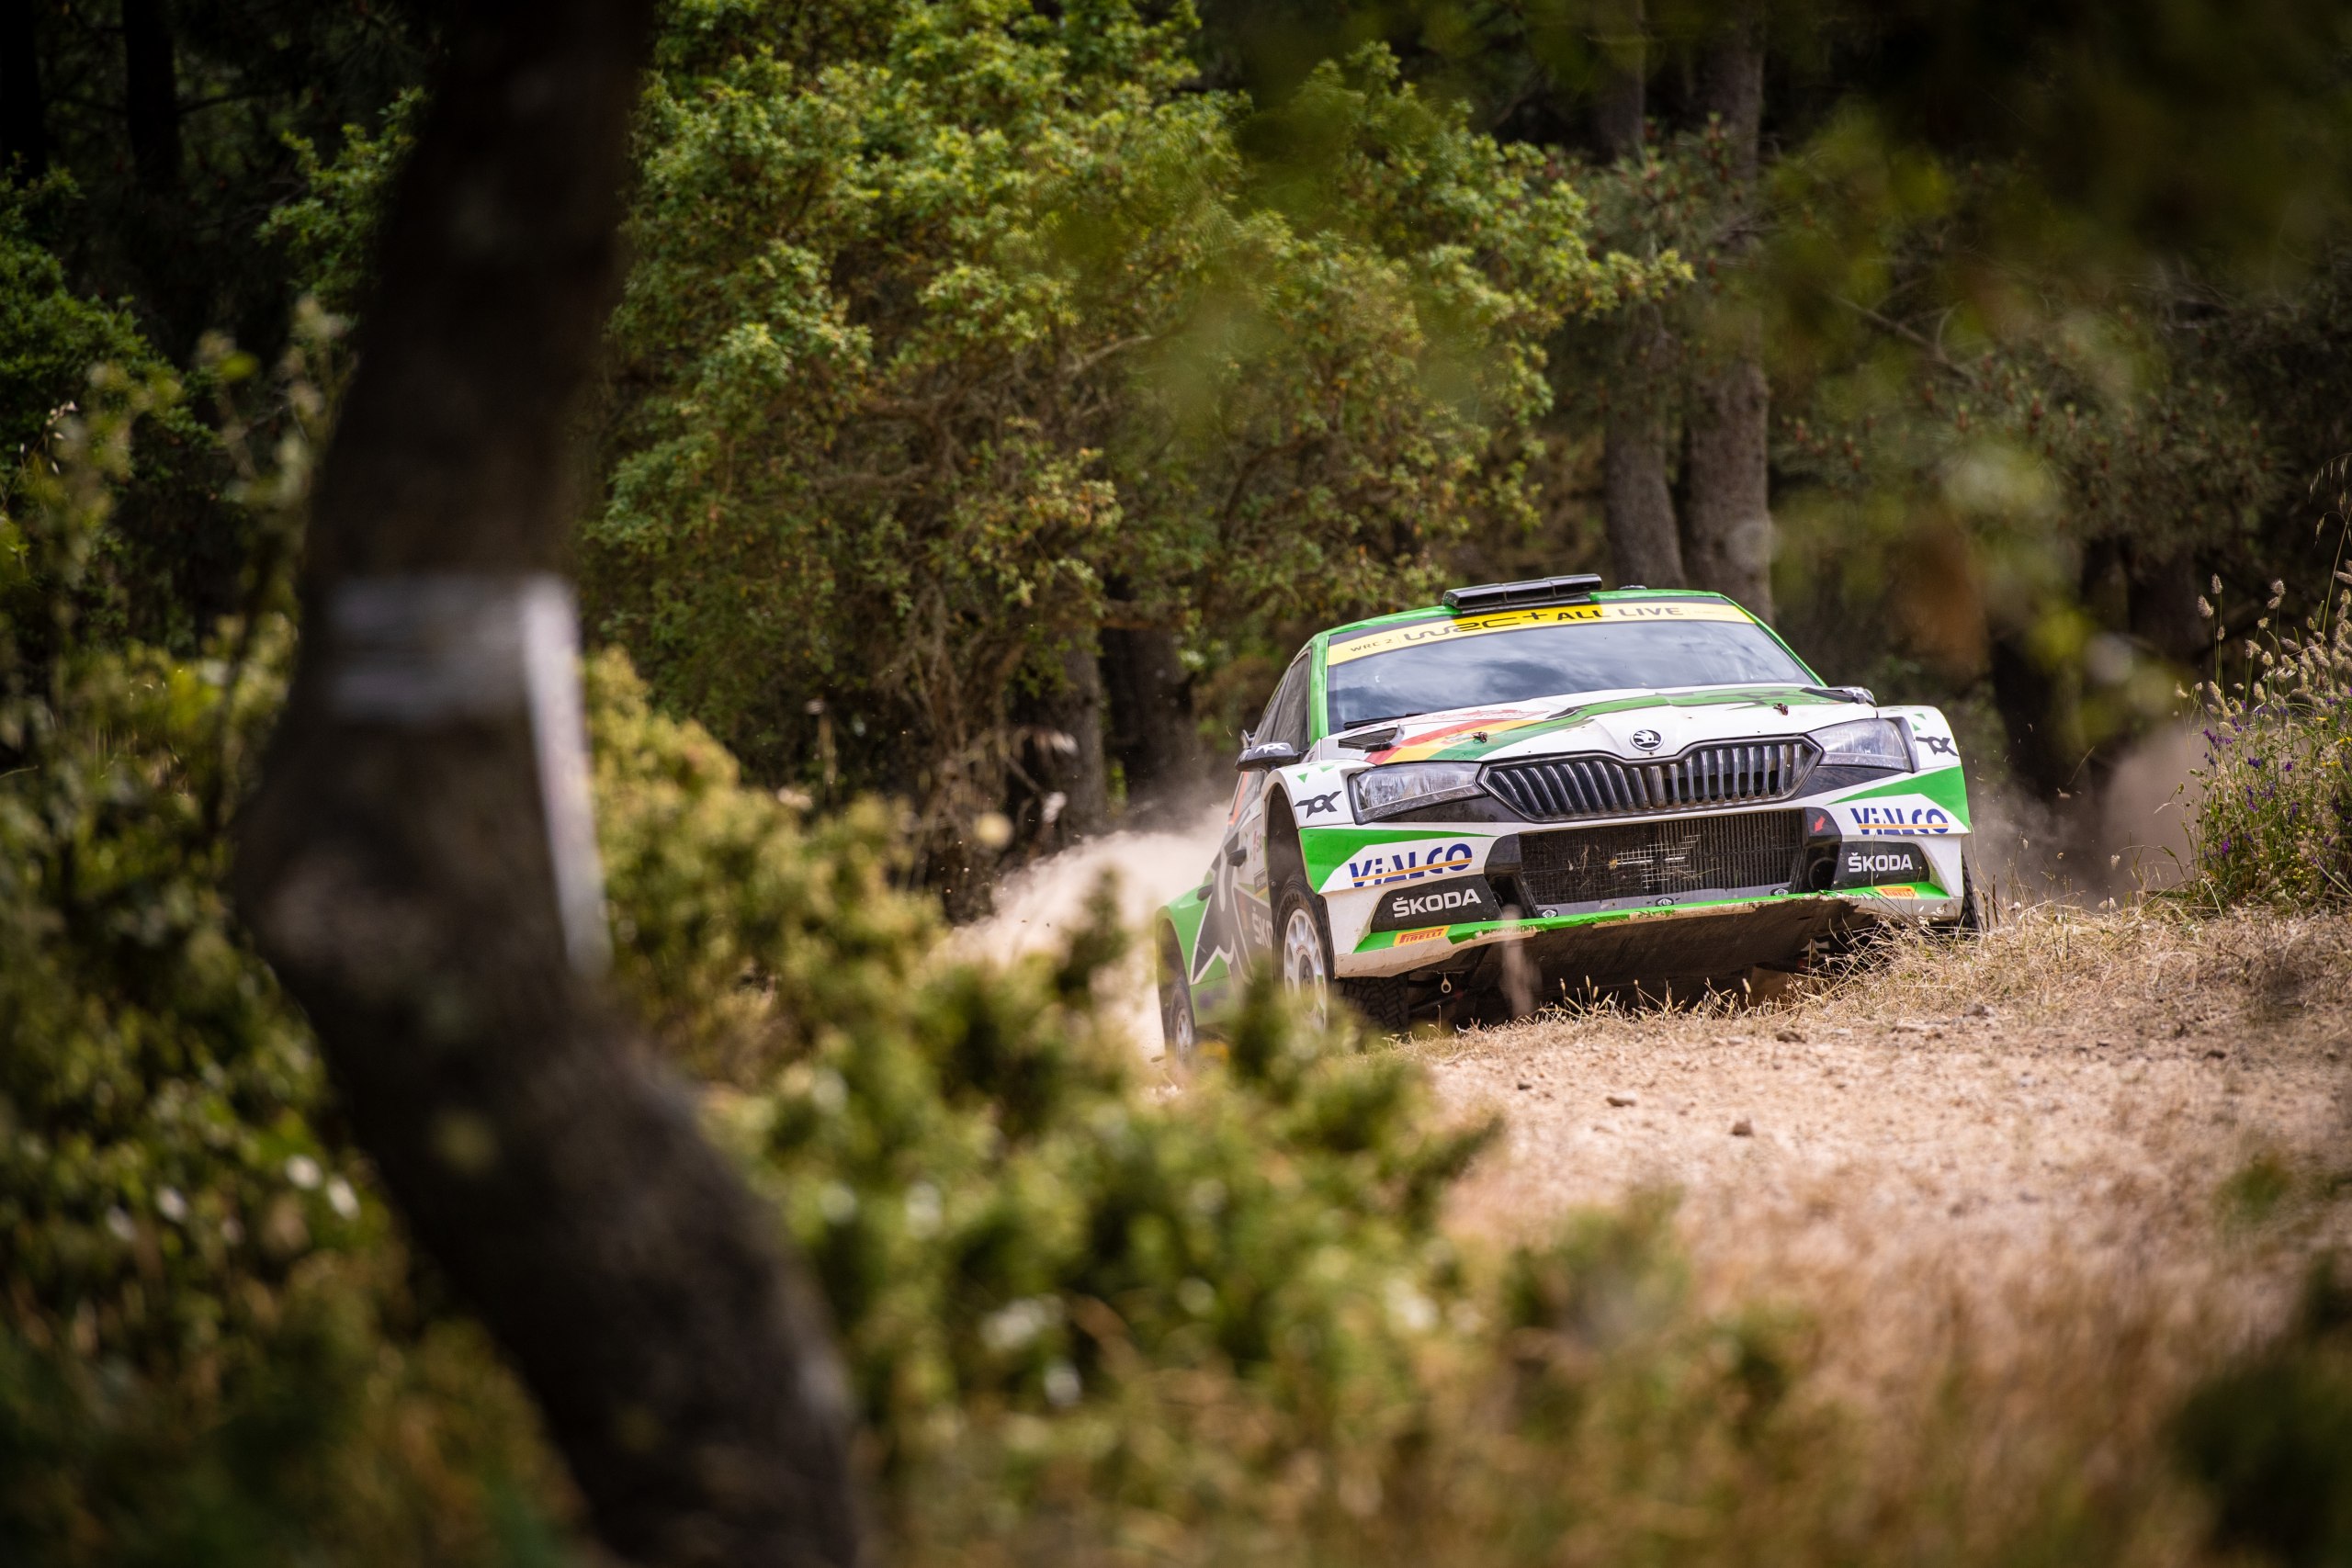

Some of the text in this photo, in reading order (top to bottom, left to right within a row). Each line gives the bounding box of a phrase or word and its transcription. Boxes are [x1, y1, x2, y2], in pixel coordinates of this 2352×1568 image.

[1557, 610, 1611, 621] ALL
[1618, 607, 1683, 616] LIVE
[1848, 852, 1914, 873] ŠKODA
[1392, 887, 1482, 919] ŠKODA
[1251, 906, 1273, 949] ŠKO
[1399, 929, 1444, 943] PIRELLI
